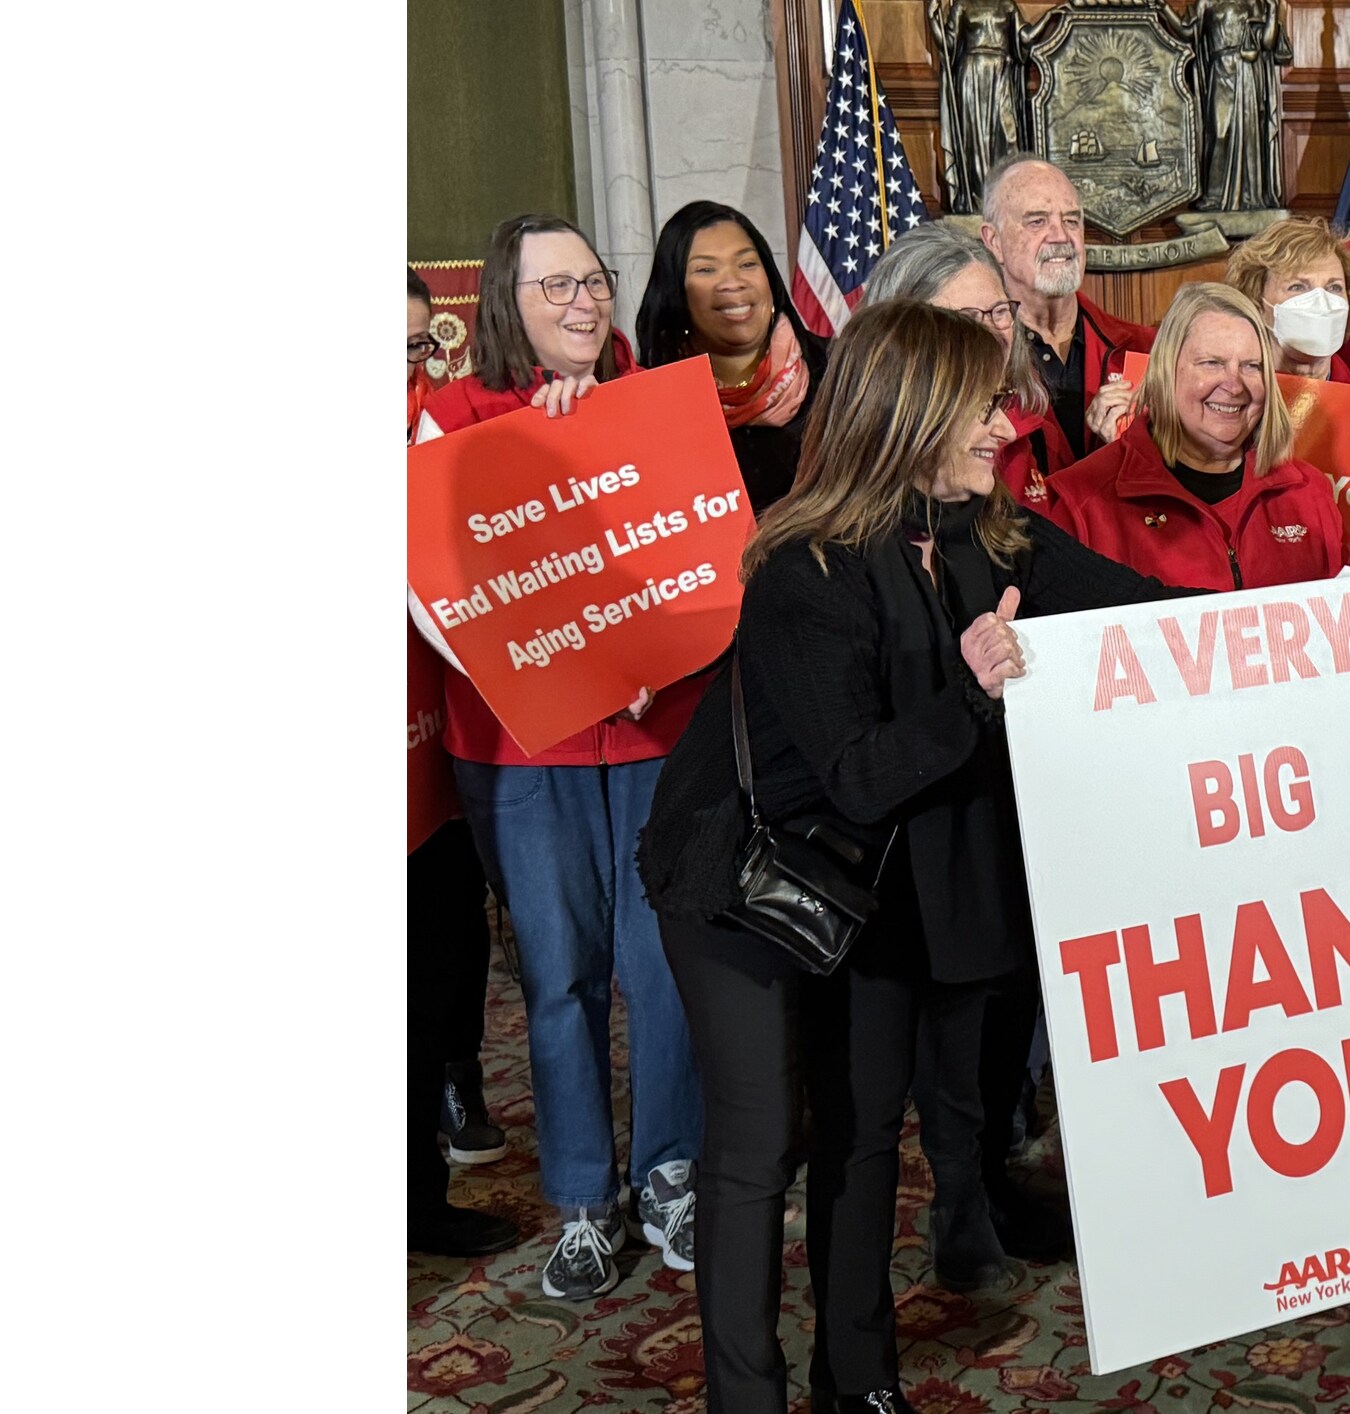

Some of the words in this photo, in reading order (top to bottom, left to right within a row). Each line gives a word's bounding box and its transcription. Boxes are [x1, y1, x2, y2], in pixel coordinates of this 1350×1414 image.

[468, 499, 546, 544] Save
[548, 464, 641, 513] Lives
[431, 585, 493, 630] End
[488, 543, 605, 605] Waiting
[604, 509, 689, 557] Lists
[693, 489, 741, 523] for
[506, 621, 587, 671] Aging
[582, 562, 717, 633] Services
[1093, 623, 1158, 712] A
[1187, 745, 1317, 849] BIG
[1276, 1292, 1312, 1313] New
